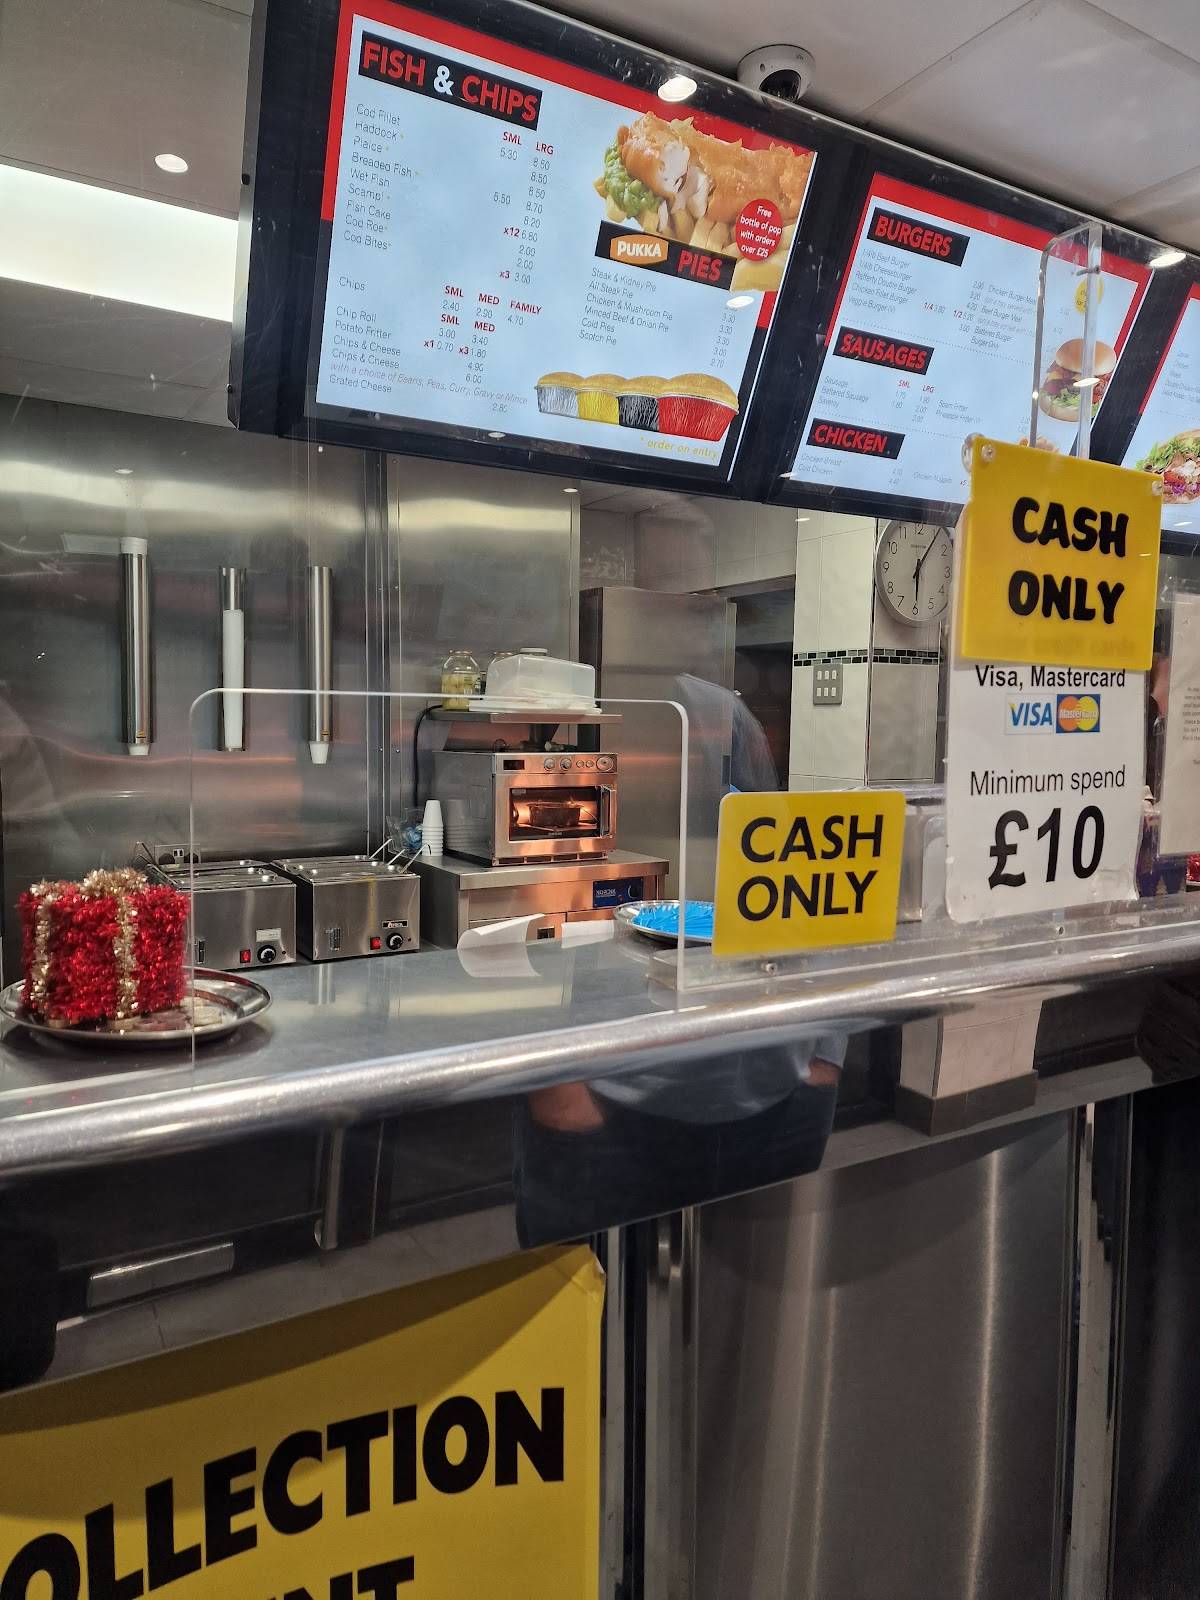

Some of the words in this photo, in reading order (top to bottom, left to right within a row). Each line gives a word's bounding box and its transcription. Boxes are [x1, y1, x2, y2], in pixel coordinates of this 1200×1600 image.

[362, 40, 426, 87] FISH
[433, 65, 454, 96] &
[462, 74, 538, 122] CHIPS
[356, 103, 375, 119] Cod
[378, 109, 400, 126] Fillet
[355, 120, 398, 141] Haddock
[353, 135, 383, 153] Plaice
[502, 131, 522, 146] SML
[535, 141, 554, 155] LRG
[352, 152, 391, 172] Breaded
[393, 163, 412, 177] Fish
[350, 168, 369, 183] Wet
[371, 174, 390, 187] Fish
[530, 171, 548, 185] 8.50
[348, 183, 384, 202] Scampi
[528, 186, 546, 200] 8.50
[346, 200, 366, 213] Fish
[368, 205, 391, 220] Cake
[526, 201, 543, 214] 8.70
[757, 205, 772, 218] Free
[345, 214, 364, 228] Cod
[366, 220, 384, 233] Roe
[503, 227, 520, 238] x12
[740, 214, 760, 228] bottle
[761, 221, 770, 231] of
[768, 226, 782, 236] pop
[343, 230, 362, 244] Cod
[365, 235, 388, 250] Bites
[740, 230, 755, 241] with
[755, 235, 776, 246] orders
[875, 214, 953, 257] BURGERS
[617, 241, 662, 258] PUKKA
[741, 245, 756, 254] over
[756, 247, 769, 258] £25
[500, 270, 511, 279] x3
[677, 250, 723, 283] PIES
[338, 276, 365, 291] Chips
[592, 267, 612, 281] Steak
[614, 272, 619, 283] &
[620, 275, 644, 289] Kidney
[645, 281, 657, 292] Pie
[589, 281, 601, 292] All
[602, 283, 620, 295] Steak
[622, 289, 634, 299] Pie
[445, 285, 465, 298] SML
[478, 293, 501, 305] MED
[510, 300, 542, 315] FAMILY
[586, 293, 616, 307] Chicken
[617, 299, 622, 309] &
[623, 301, 661, 317] Mushroom
[662, 311, 673, 321] Pie
[336, 306, 358, 320] Chip
[360, 311, 377, 323] Roll
[442, 300, 460, 312] 2.40
[507, 314, 524, 326] 4.70
[584, 305, 611, 319] Minced
[613, 311, 629, 323] Beef
[629, 315, 635, 325] &
[637, 317, 657, 329] Onion
[335, 320, 364, 334] Potato
[366, 326, 392, 339] Fritter
[441, 313, 460, 326] SML
[474, 320, 496, 333] MED
[581, 318, 598, 329] Cold
[600, 321, 615, 333] Pies
[333, 334, 358, 349] Chips
[361, 340, 367, 350] &
[370, 342, 401, 356] Cheese
[438, 327, 456, 339] 3.00
[471, 334, 489, 346] 3.40
[578, 330, 604, 342] Scotch
[606, 334, 617, 345] Pie
[424, 339, 435, 349] x1
[437, 341, 454, 353] 0.70
[458, 346, 469, 355] x3
[841, 333, 927, 369] SAUSAGES
[332, 348, 358, 361] Chips
[359, 354, 365, 363] &
[368, 355, 400, 369] Cheese
[331, 362, 349, 373] with
[359, 368, 386, 380] choice
[388, 373, 396, 382] of
[329, 374, 358, 388] Grated
[360, 379, 393, 393] Cheese
[814, 424, 887, 454] CHICKEN
[647, 438, 675, 452] order
[677, 445, 690, 454] on
[692, 446, 718, 460] entry
[899, 526, 907, 539] 11
[1012, 496, 1129, 558] CASH
[888, 541, 898, 555] 10
[941, 544, 948, 557] 2
[883, 561, 890, 574] 9
[945, 566, 951, 579] 3
[887, 581, 894, 594] 8
[1008, 570, 1125, 624] ONLY
[897, 595, 905, 607] 7
[912, 603, 919, 615] 6
[928, 598, 934, 610] 5
[976, 665, 1023, 691] Visa,
[1031, 665, 1126, 688] Mastercard
[1008, 702, 1053, 727] VISA
[970, 769, 1064, 796] Minimum
[1071, 764, 1126, 796] spend
[741, 814, 884, 863] CASH
[988, 805, 1105, 890] £10
[737, 870, 878, 922] ONLY
